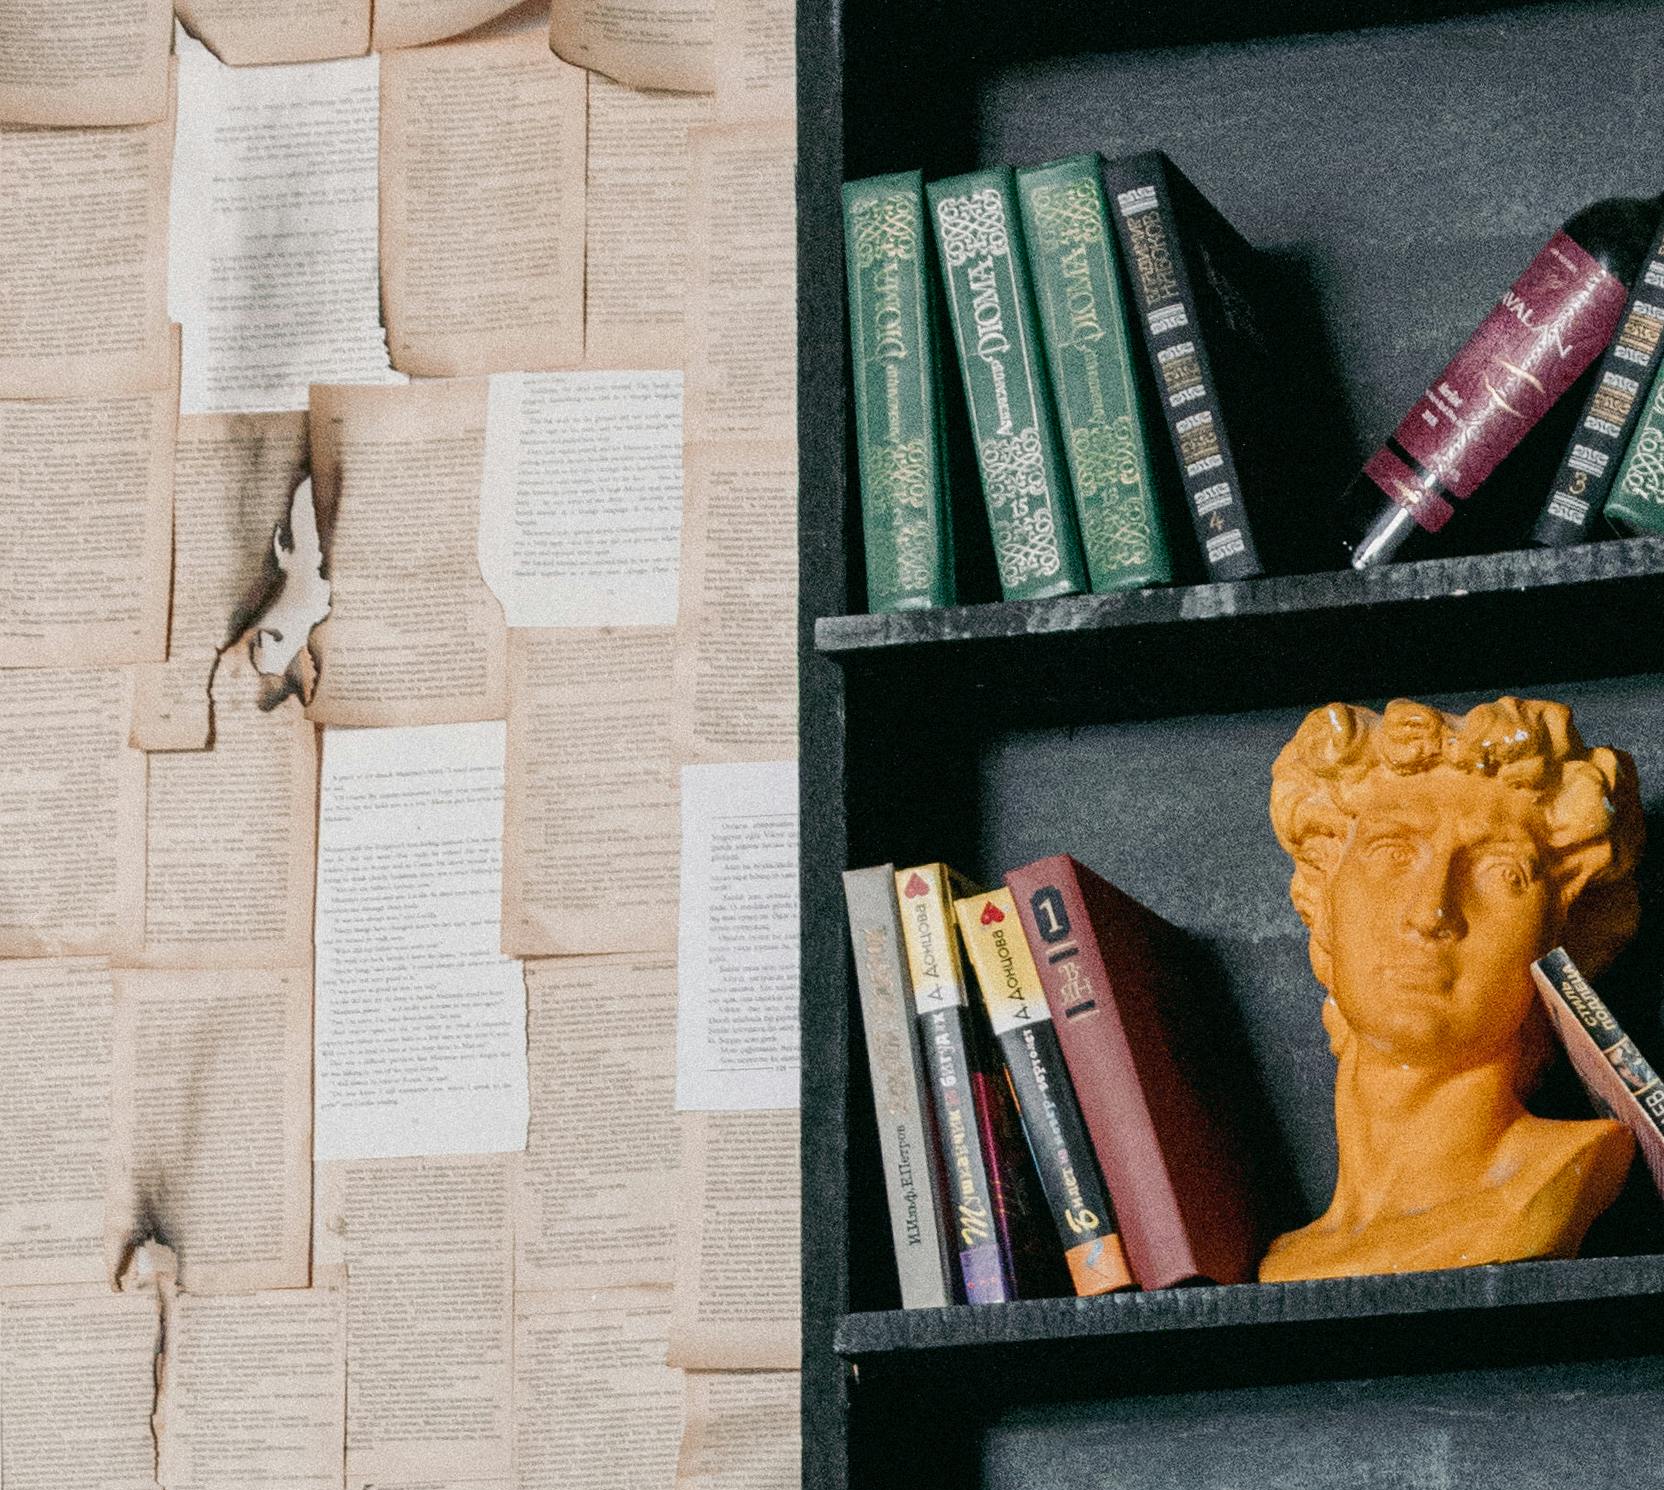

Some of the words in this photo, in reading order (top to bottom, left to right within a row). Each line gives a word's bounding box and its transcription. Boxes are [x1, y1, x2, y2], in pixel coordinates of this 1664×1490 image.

[1141, 210, 1181, 299] НАБОКОВ
[967, 254, 1011, 363] ДЮМА
[1010, 498, 1029, 518] 15
[1567, 470, 1589, 496] 3
[1207, 510, 1225, 533] 4
[914, 902, 941, 980] Донцова
[1038, 896, 1064, 934] 1
[992, 928, 1026, 1001] Донцова
[1064, 1166, 1101, 1235] Билет
